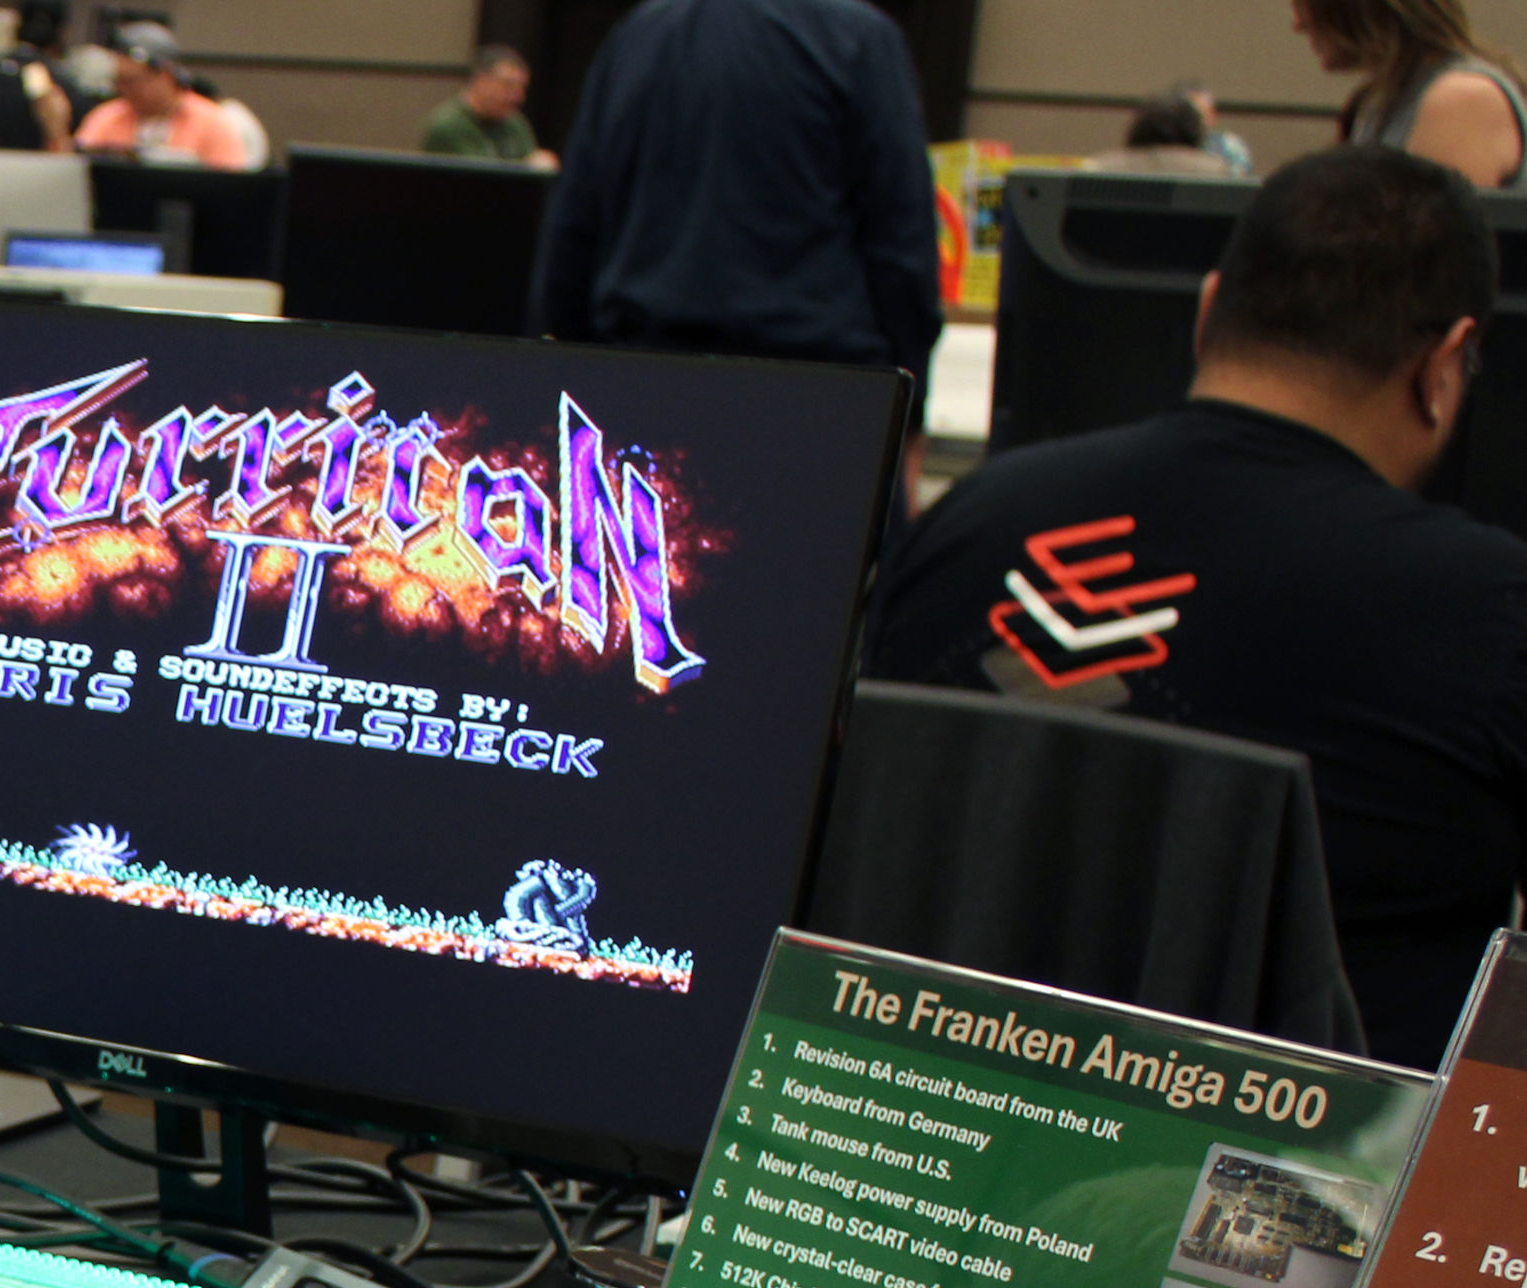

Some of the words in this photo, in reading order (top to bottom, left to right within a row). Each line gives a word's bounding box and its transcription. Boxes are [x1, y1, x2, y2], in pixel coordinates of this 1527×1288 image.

[112, 649, 138, 674] &
[158, 655, 438, 713] SOUNDEFFECTS
[459, 692, 530, 723] BY:
[176, 685, 604, 778] HUELSBECK
[98, 1049, 147, 1078] DELL
[764, 1033, 777, 1052] 1.
[794, 1040, 867, 1075] Revision
[869, 1060, 892, 1083] 6A
[895, 1070, 954, 1098] circuit
[954, 1081, 1009, 1112] board
[1009, 1096, 1054, 1124] from
[1057, 1109, 1089, 1133] the
[1092, 1117, 1124, 1142] UK
[833, 970, 901, 1025] The
[908, 990, 1076, 1068] Franken
[1081, 1034, 1225, 1109] Amiga
[1234, 1070, 1327, 1129] 500
[737, 1105, 752, 1126] 3.
[771, 1113, 810, 1141] Tank
[810, 1129, 870, 1157] mouse
[871, 1142, 914, 1170] from
[916, 1154, 952, 1181] U.S.
[748, 1069, 764, 1089] 2.
[782, 1077, 864, 1115] Keyboard
[863, 1099, 906, 1126] from
[908, 1111, 992, 1152] Germany
[1472, 1103, 1497, 1135] 1.
[713, 1178, 728, 1199] 5.
[745, 1187, 785, 1214] New
[785, 1199, 825, 1226] RGB
[826, 1212, 845, 1232] to
[845, 1217, 910, 1251] SCART
[910, 1237, 959, 1266] video
[961, 1255, 1013, 1282] cable
[725, 1143, 740, 1162] 4.
[757, 1150, 797, 1177] New
[798, 1162, 858, 1199] Keelog
[856, 1183, 915, 1211] power
[914, 1199, 978, 1232] supply
[978, 1213, 1024, 1243] from
[1025, 1226, 1094, 1263] Poland
[690, 1250, 704, 1271] 7.
[701, 1215, 716, 1235] 6.
[733, 1223, 773, 1251] New
[773, 1240, 884, 1285] crystal-clear
[1415, 1230, 1447, 1263] 2.
